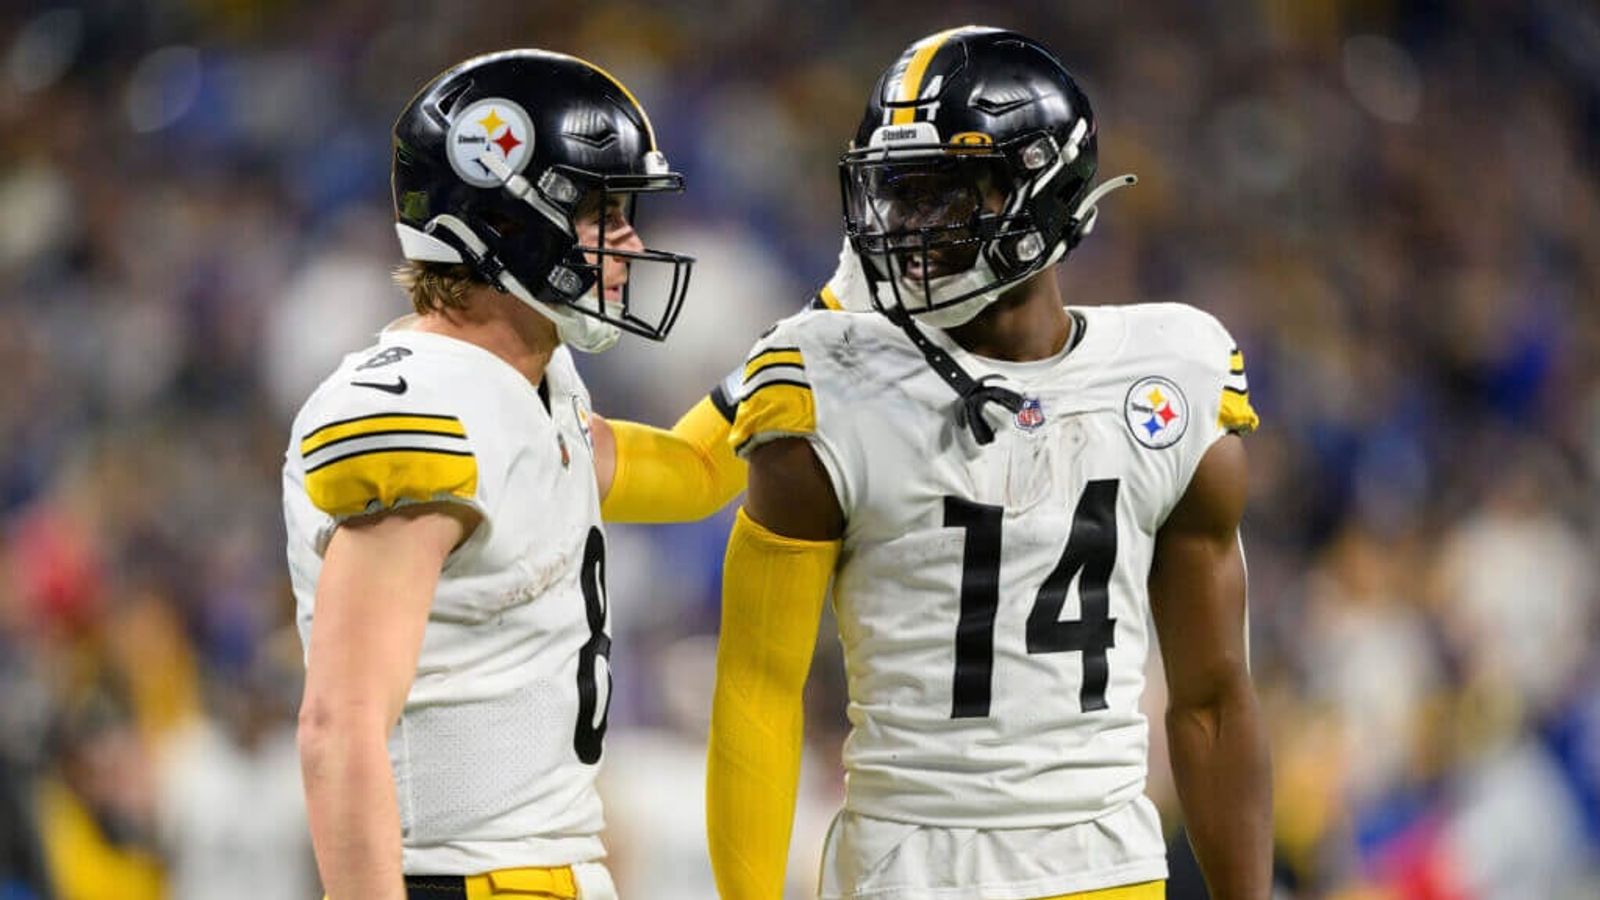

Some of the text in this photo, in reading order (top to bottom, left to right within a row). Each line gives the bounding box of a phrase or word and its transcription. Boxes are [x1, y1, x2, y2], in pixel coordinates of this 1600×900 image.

[881, 128, 917, 141] Steelers
[574, 525, 612, 765] 8
[943, 478, 1120, 719] 14
